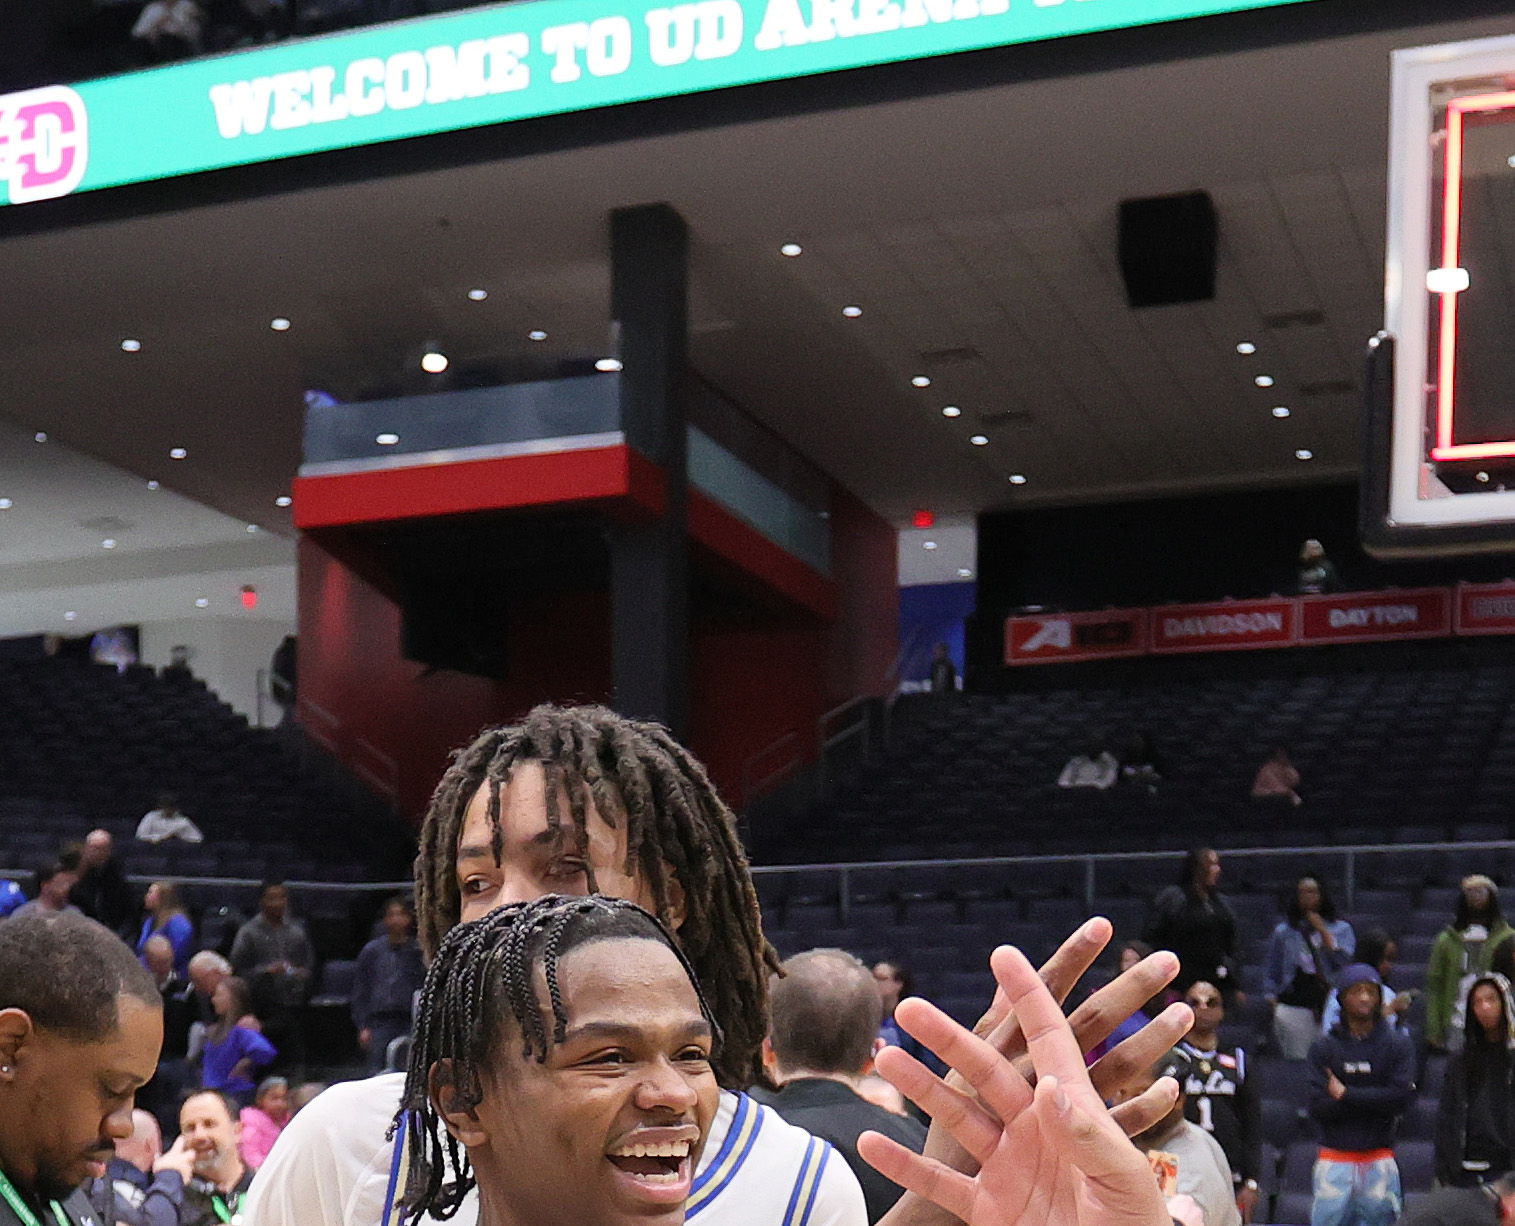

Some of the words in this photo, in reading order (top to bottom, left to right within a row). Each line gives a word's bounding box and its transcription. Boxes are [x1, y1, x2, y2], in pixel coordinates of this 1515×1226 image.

[208, 32, 531, 140] WELCOME
[540, 16, 633, 84] TO
[644, 0, 745, 68] UD
[1164, 612, 1282, 638] DAVIDSON
[1329, 604, 1419, 628] DAYTON
[1197, 1096, 1215, 1132] 1
